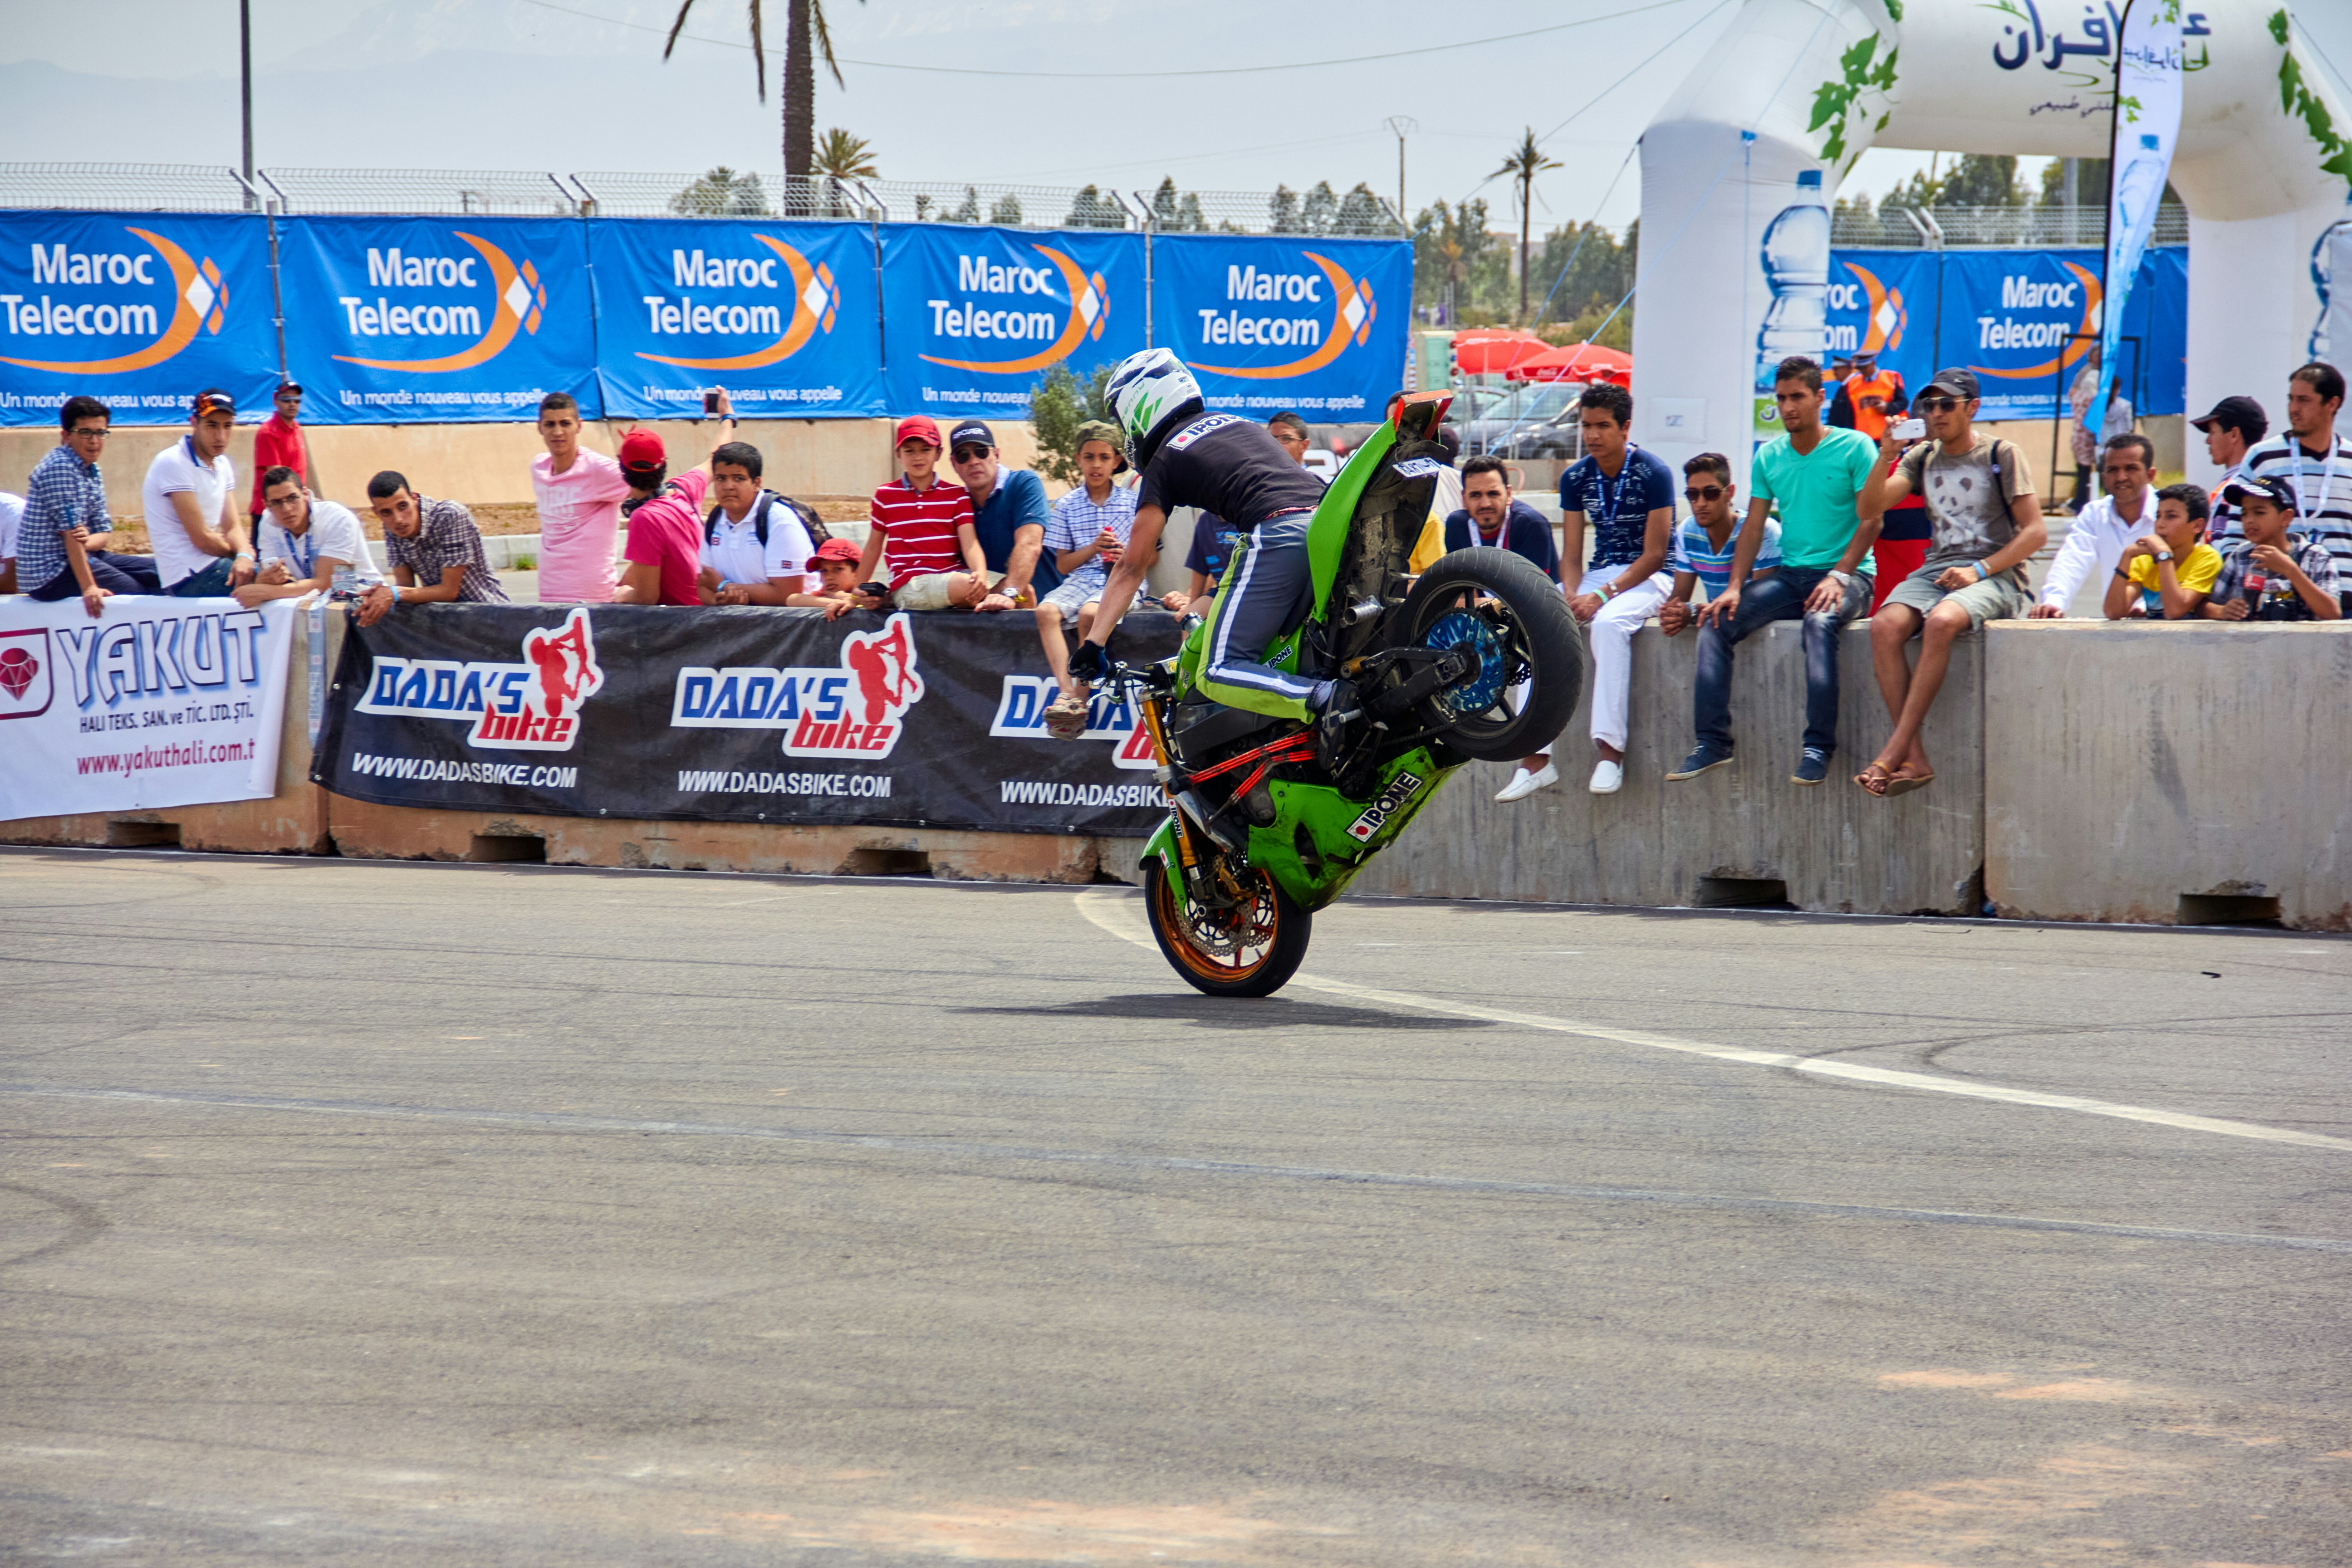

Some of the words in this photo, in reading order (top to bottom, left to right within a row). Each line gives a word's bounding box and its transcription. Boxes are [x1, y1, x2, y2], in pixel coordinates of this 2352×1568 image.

[31, 244, 154, 284] Maroc
[368, 248, 476, 287] Maroc
[672, 250, 778, 288] Maroc
[959, 255, 1054, 295] Maroc
[1227, 265, 1321, 302] Maroc
[2002, 275, 2078, 309] Maroc
[0, 295, 158, 335] Telecom
[339, 297, 481, 335] Telecom
[643, 297, 780, 334] Telecom
[928, 300, 1054, 340] Telecom
[1199, 309, 1319, 345] Telecom
[1977, 317, 2070, 349] Telecom
[0, 392, 21, 407] Un
[141, 395, 177, 407] vous
[340, 390, 362, 405] Un
[365, 389, 413, 404] monde
[415, 392, 472, 404] nouveau
[472, 392, 502, 404] vous
[643, 386, 664, 401] Un
[768, 389, 799, 400] vous
[799, 386, 843, 403] appelle
[922, 387, 938, 401] Un
[940, 388, 981, 402] monde
[1207, 394, 1245, 408] monde
[1246, 397, 1296, 408] nouveau
[1298, 397, 1324, 408] vous
[1325, 395, 1365, 410] appelle
[55, 609, 266, 708] YAKUT
[1268, 646, 1293, 668] IPONE
[370, 665, 531, 714] DADA'S
[681, 676, 848, 720] DADA'S
[79, 715, 105, 733] HALI
[108, 712, 138, 730] TEKS.
[142, 710, 168, 727] SAN.
[170, 713, 183, 724] ve
[210, 704, 231, 721] LTD.
[476, 702, 573, 742] bike
[790, 707, 894, 750] bike
[353, 753, 578, 788] WWW.DADASBIKE.COM
[678, 770, 892, 798] WWW.DADASBIKE.COM
[1361, 773, 1422, 828] IPONE
[1169, 807, 1183, 838] IPONE
